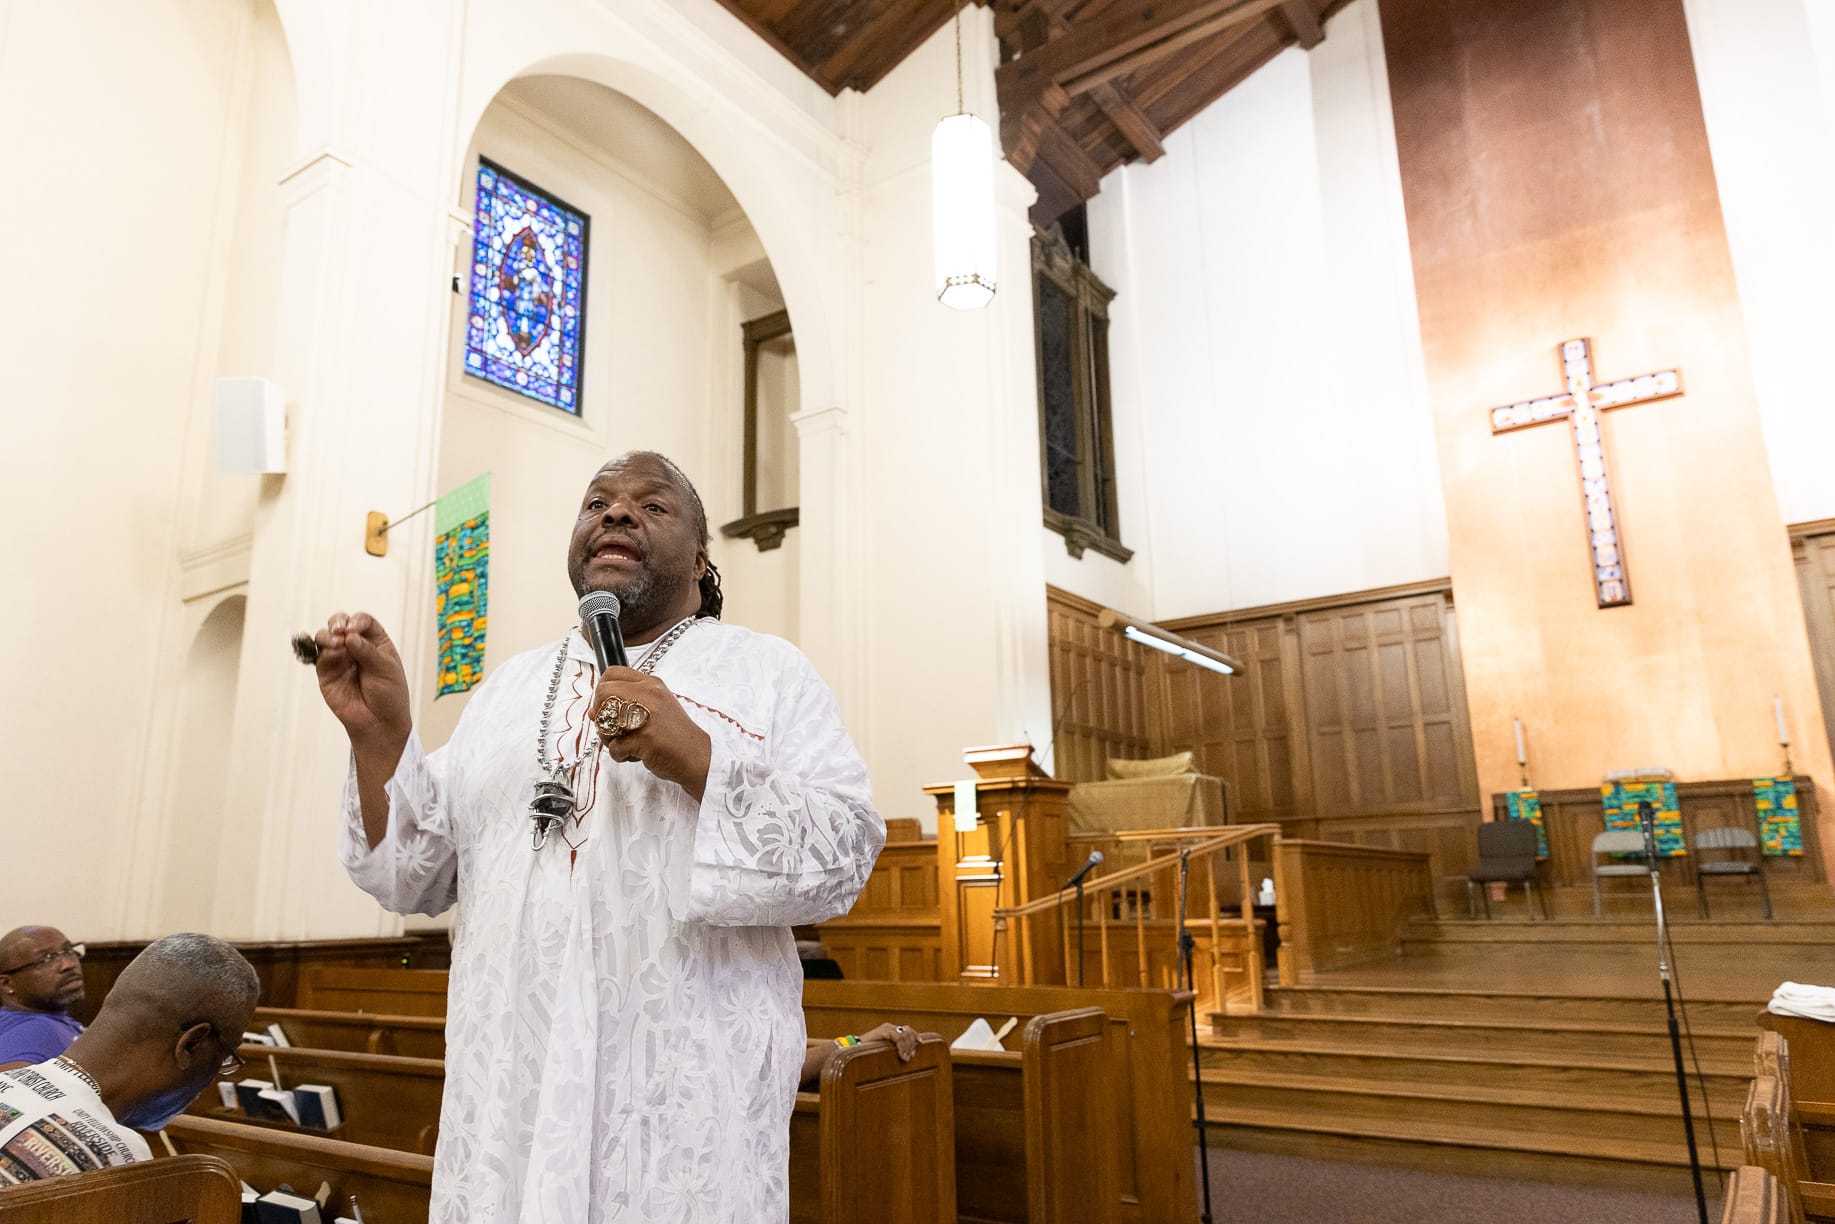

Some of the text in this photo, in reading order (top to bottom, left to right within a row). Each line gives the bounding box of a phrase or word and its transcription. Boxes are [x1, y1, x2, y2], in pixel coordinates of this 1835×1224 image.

[23, 1136, 77, 1175] RIVERSI
[72, 1120, 118, 1158] RIVERSIDE
[115, 1141, 136, 1163] CHURC
